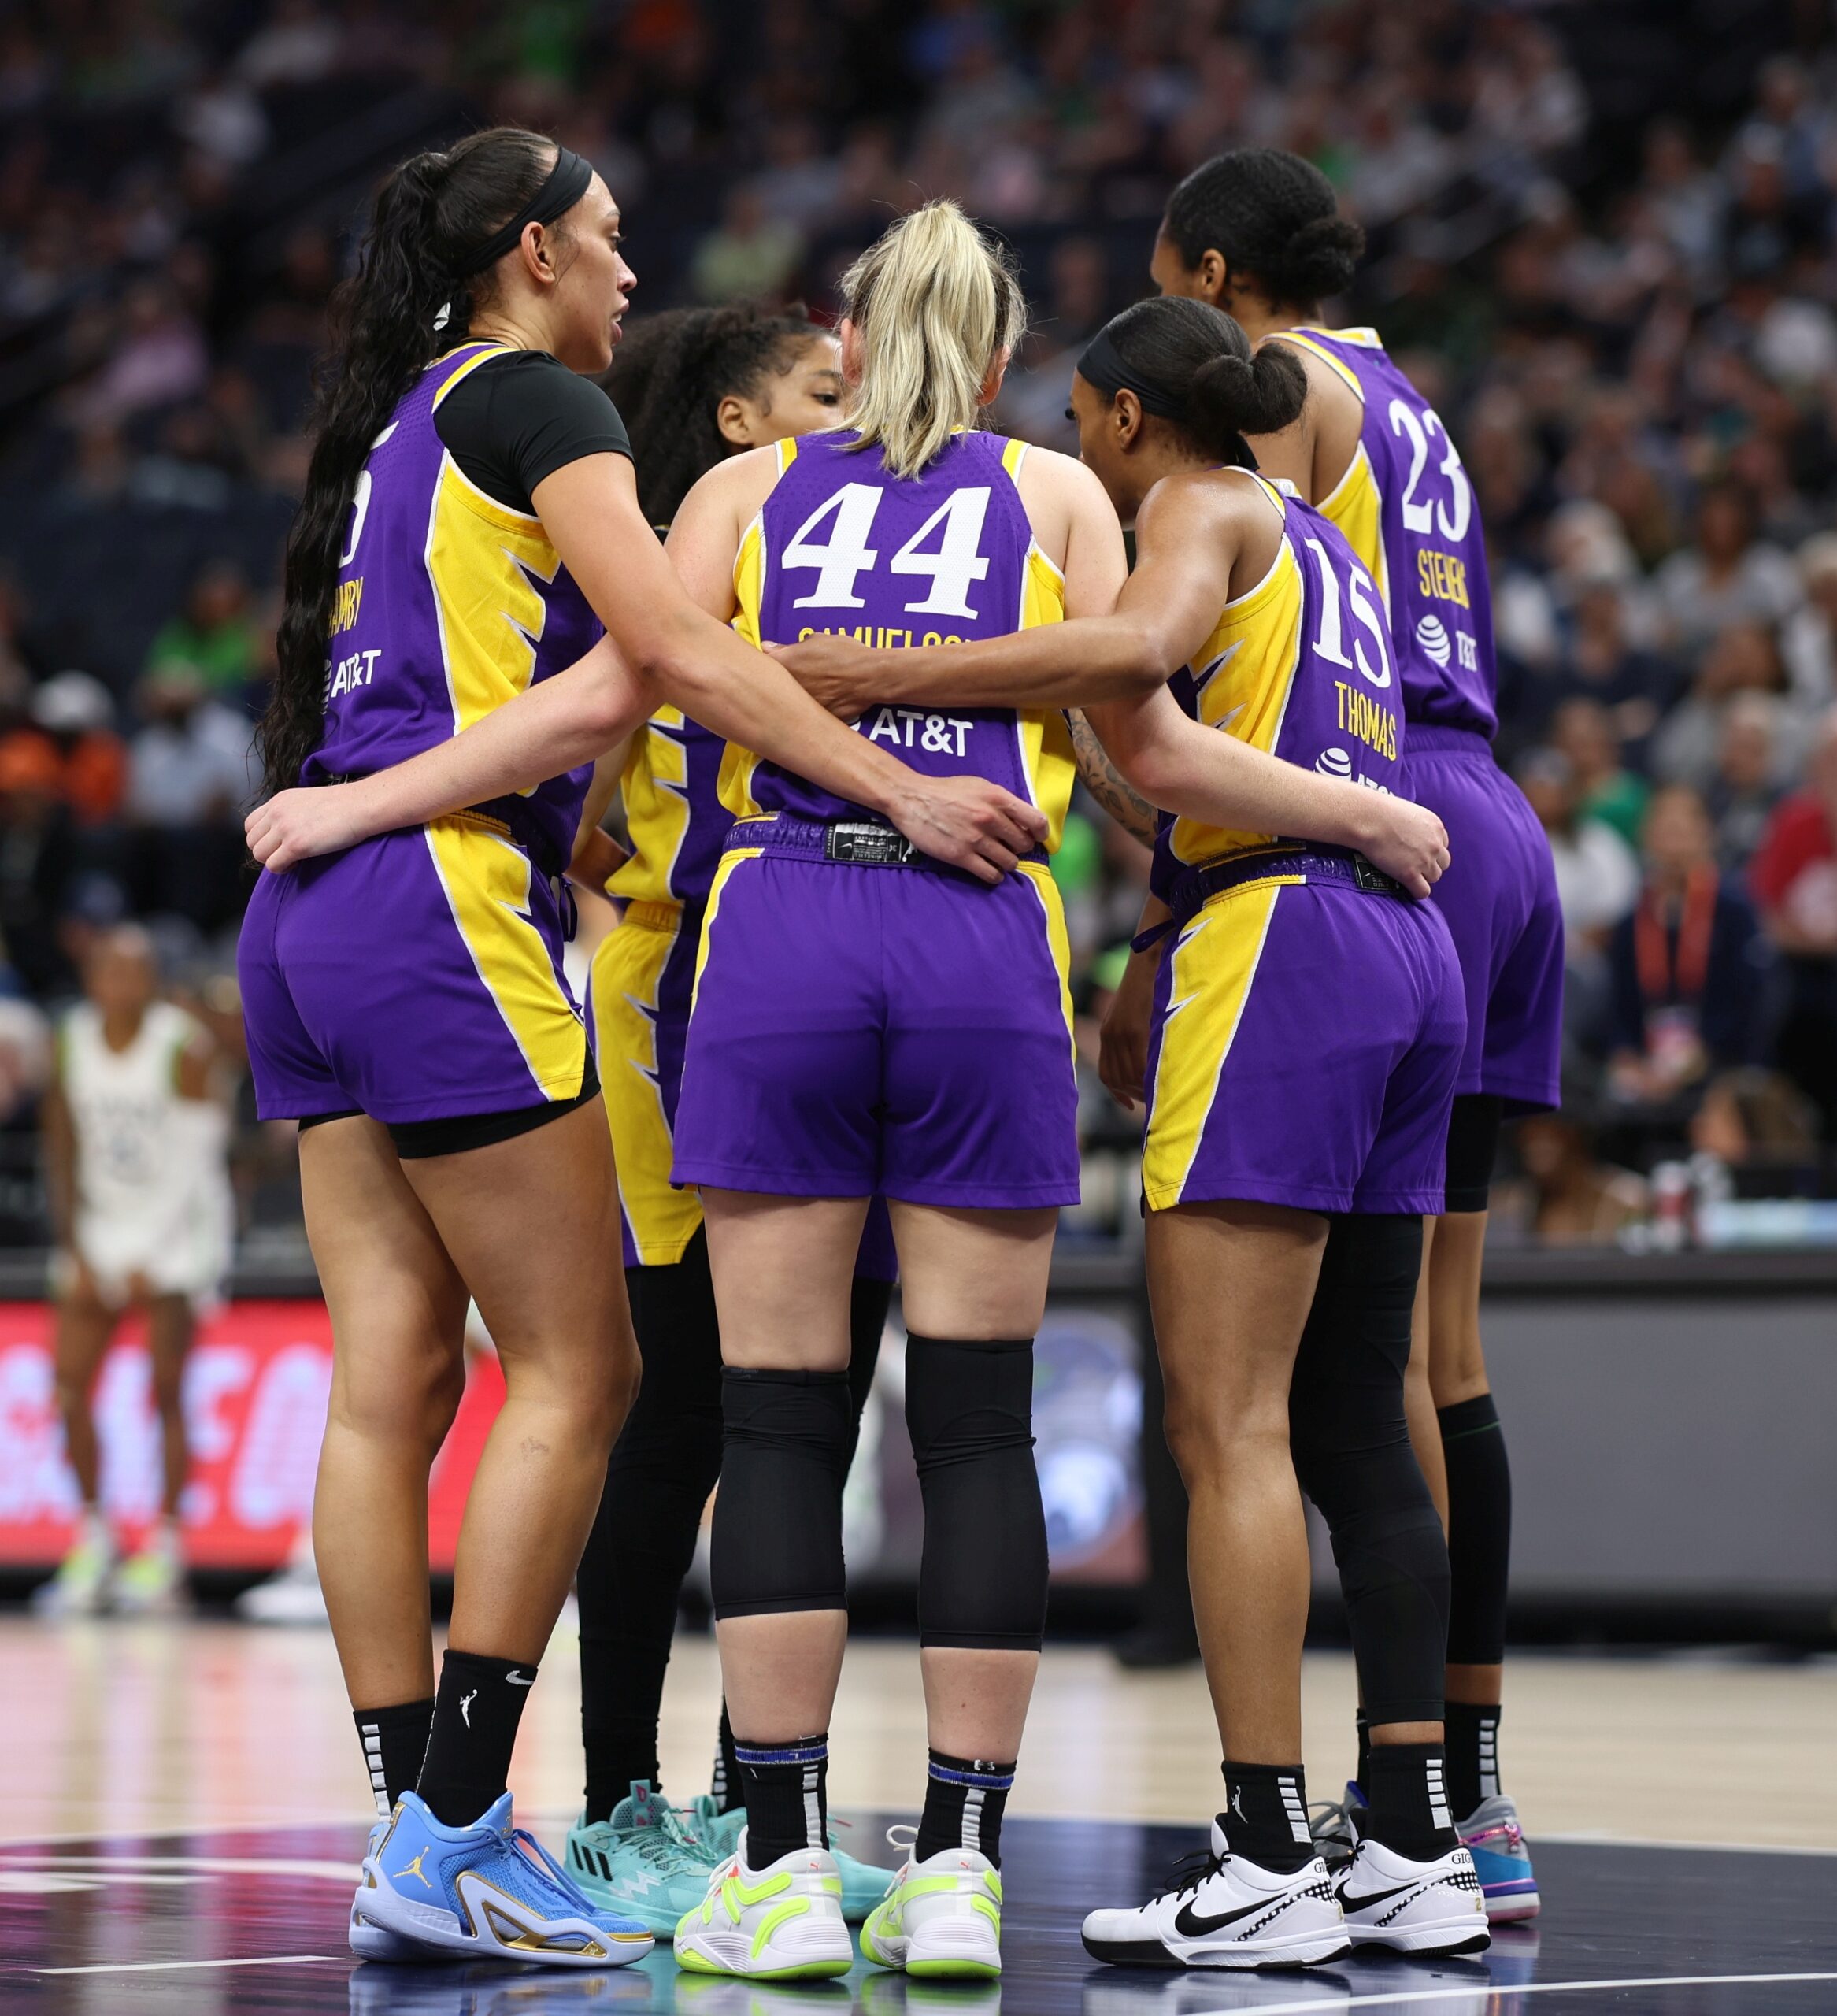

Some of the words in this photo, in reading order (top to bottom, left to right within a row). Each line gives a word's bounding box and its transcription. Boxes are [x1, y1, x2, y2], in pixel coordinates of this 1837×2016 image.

[1388, 398, 1471, 543] 23
[781, 482, 991, 619] 44
[328, 576, 364, 639] AMBY
[1304, 538, 1391, 689] 15
[331, 649, 382, 698] AT&T
[869, 709, 973, 757] AT&T
[1335, 680, 1396, 762] THOMAS
[1451, 1853, 1474, 1865] GIG
